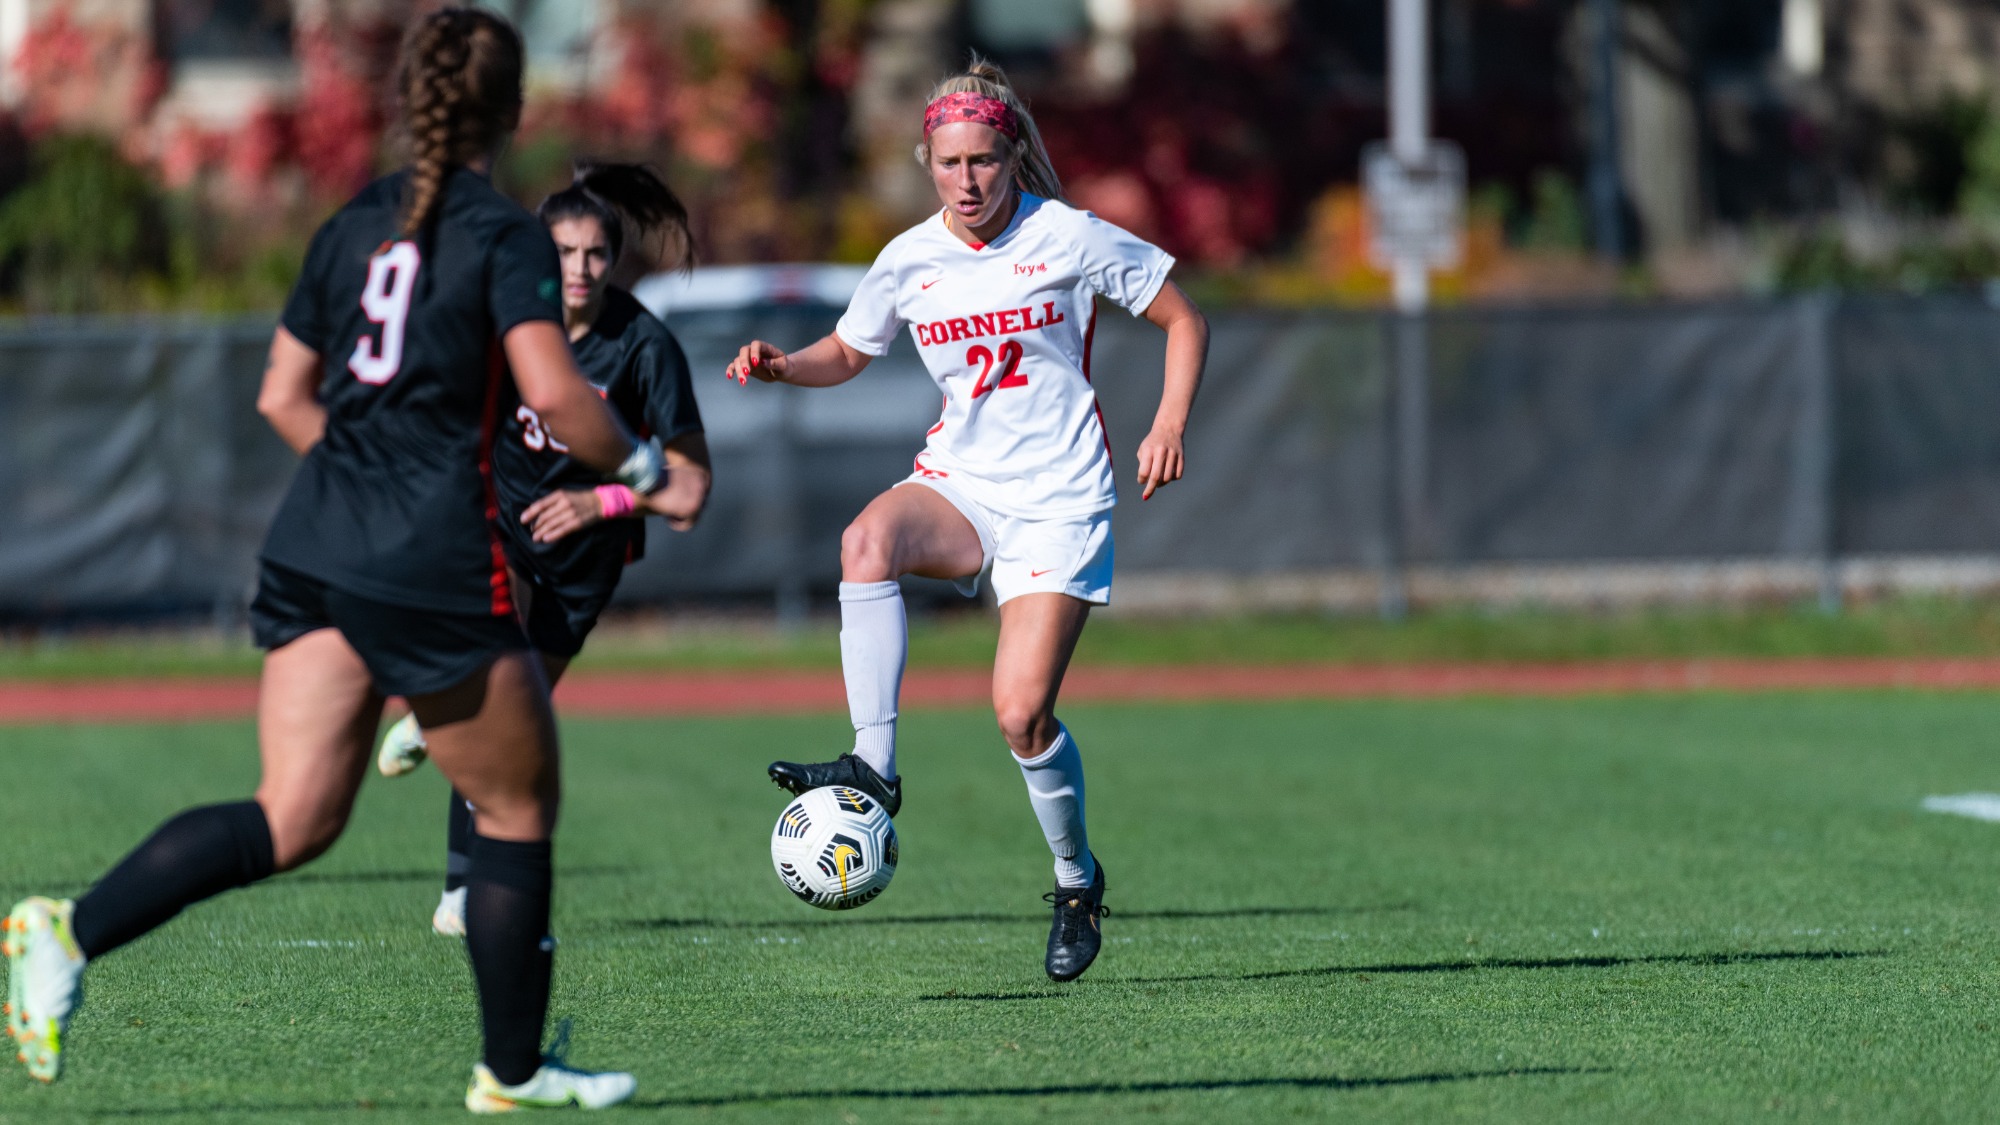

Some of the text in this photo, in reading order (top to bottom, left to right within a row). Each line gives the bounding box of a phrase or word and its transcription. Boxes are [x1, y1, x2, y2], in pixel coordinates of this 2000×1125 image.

[1013, 263, 1035, 277] Ivy
[347, 239, 422, 386] 9
[916, 301, 1064, 347] CORNELL
[966, 339, 1029, 399] 22
[517, 404, 569, 452] 3
